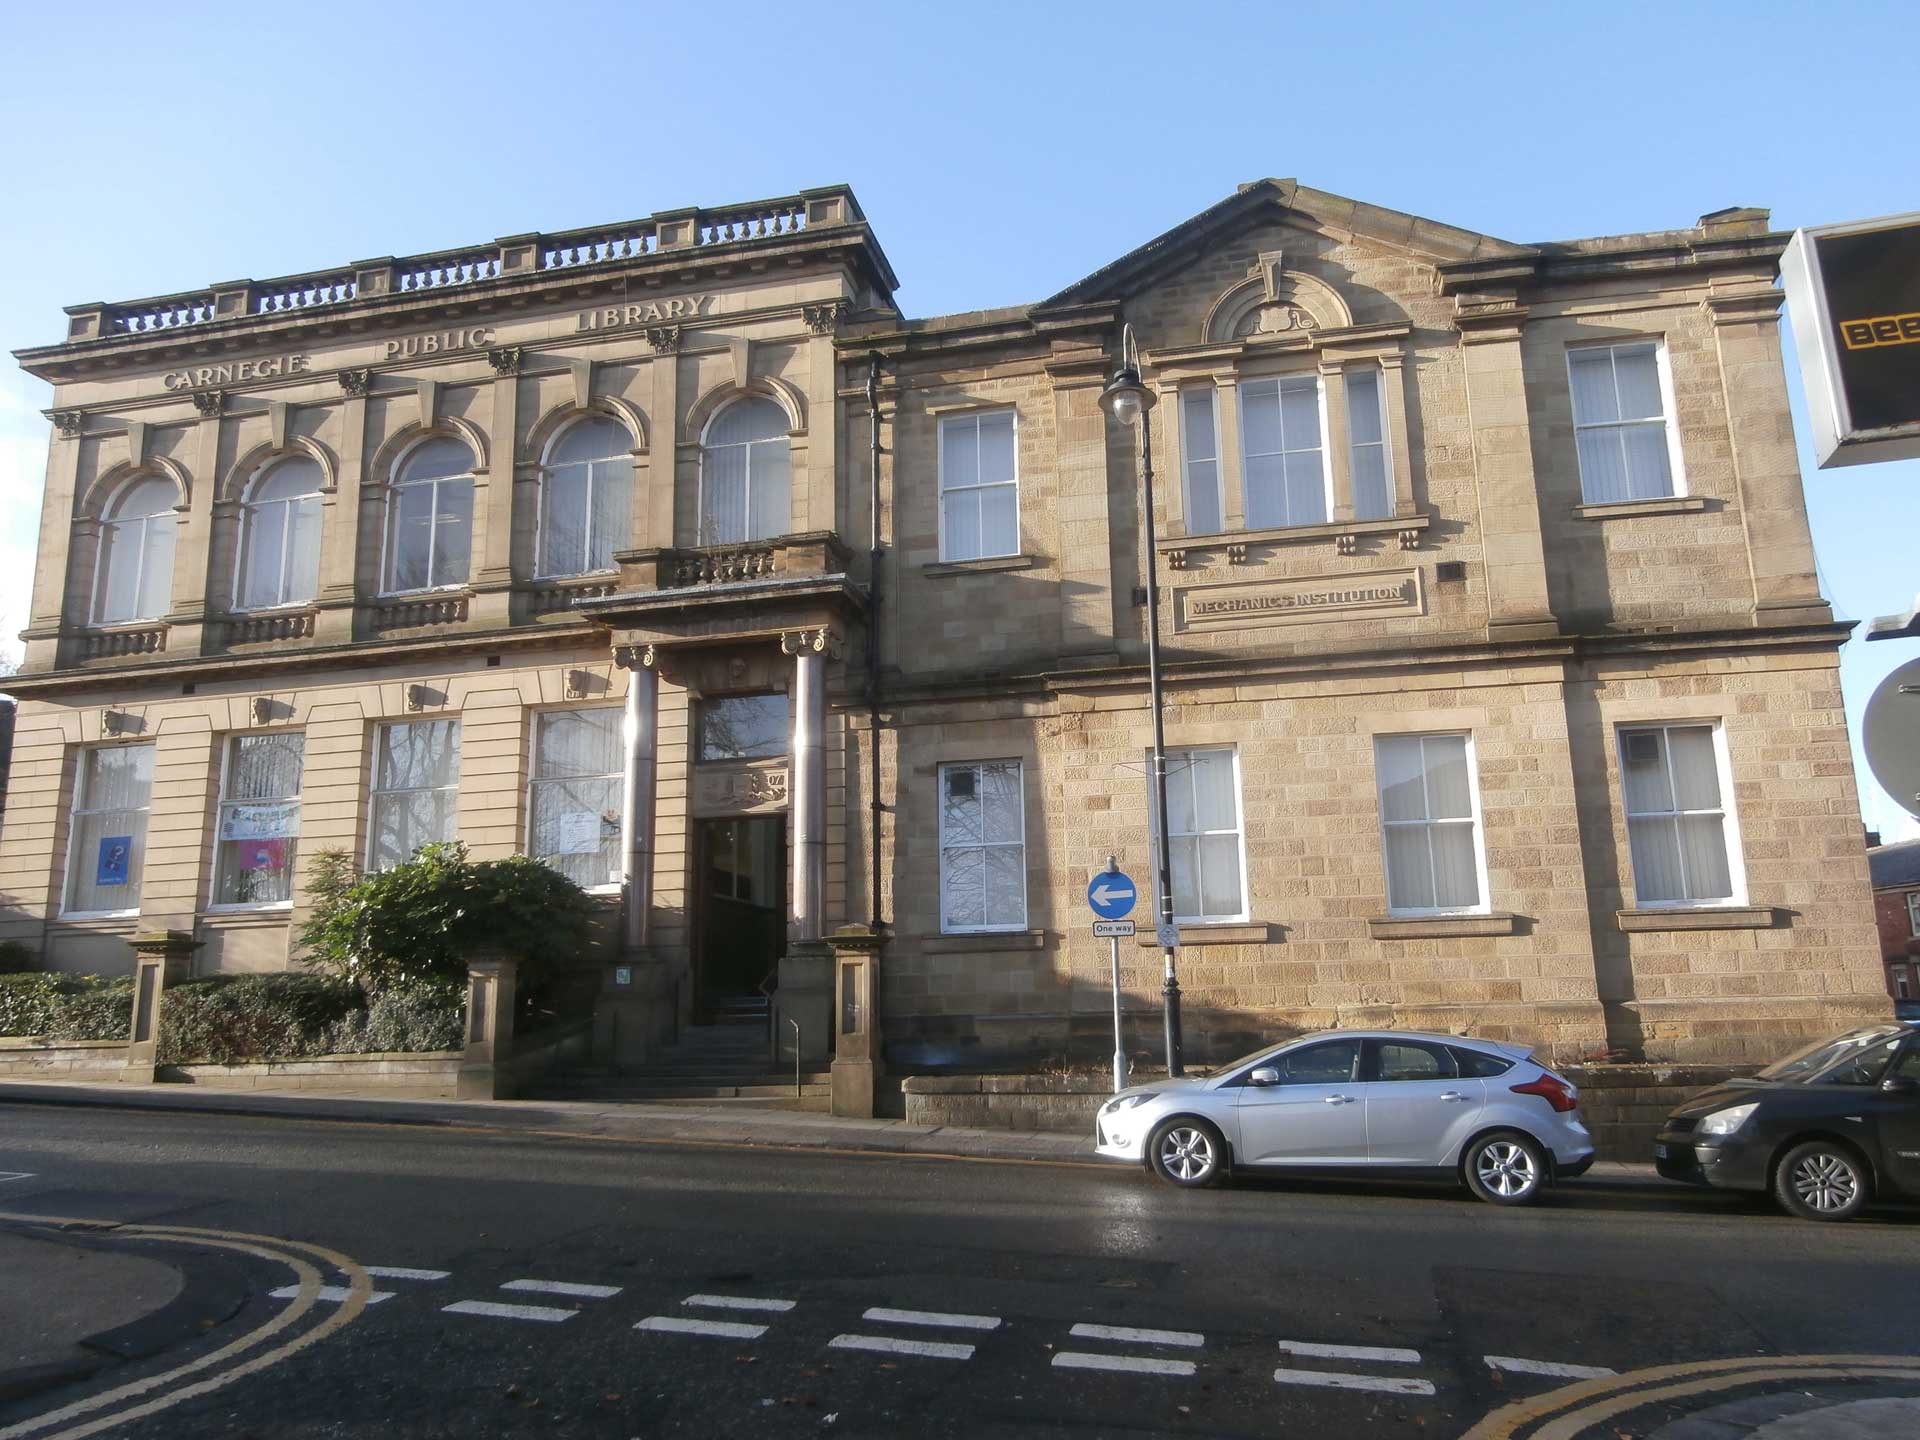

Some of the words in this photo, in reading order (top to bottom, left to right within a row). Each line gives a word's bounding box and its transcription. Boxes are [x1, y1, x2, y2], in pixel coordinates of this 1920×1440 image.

[163, 354, 302, 391] CARNEGIE
[383, 328, 486, 361] PUBLIC
[575, 296, 706, 333] LIBRARY
[1191, 597, 1291, 614] MECHANICS
[1295, 586, 1401, 606] INSTITUTION
[1096, 925, 1113, 933] One
[1115, 925, 1132, 933] way
